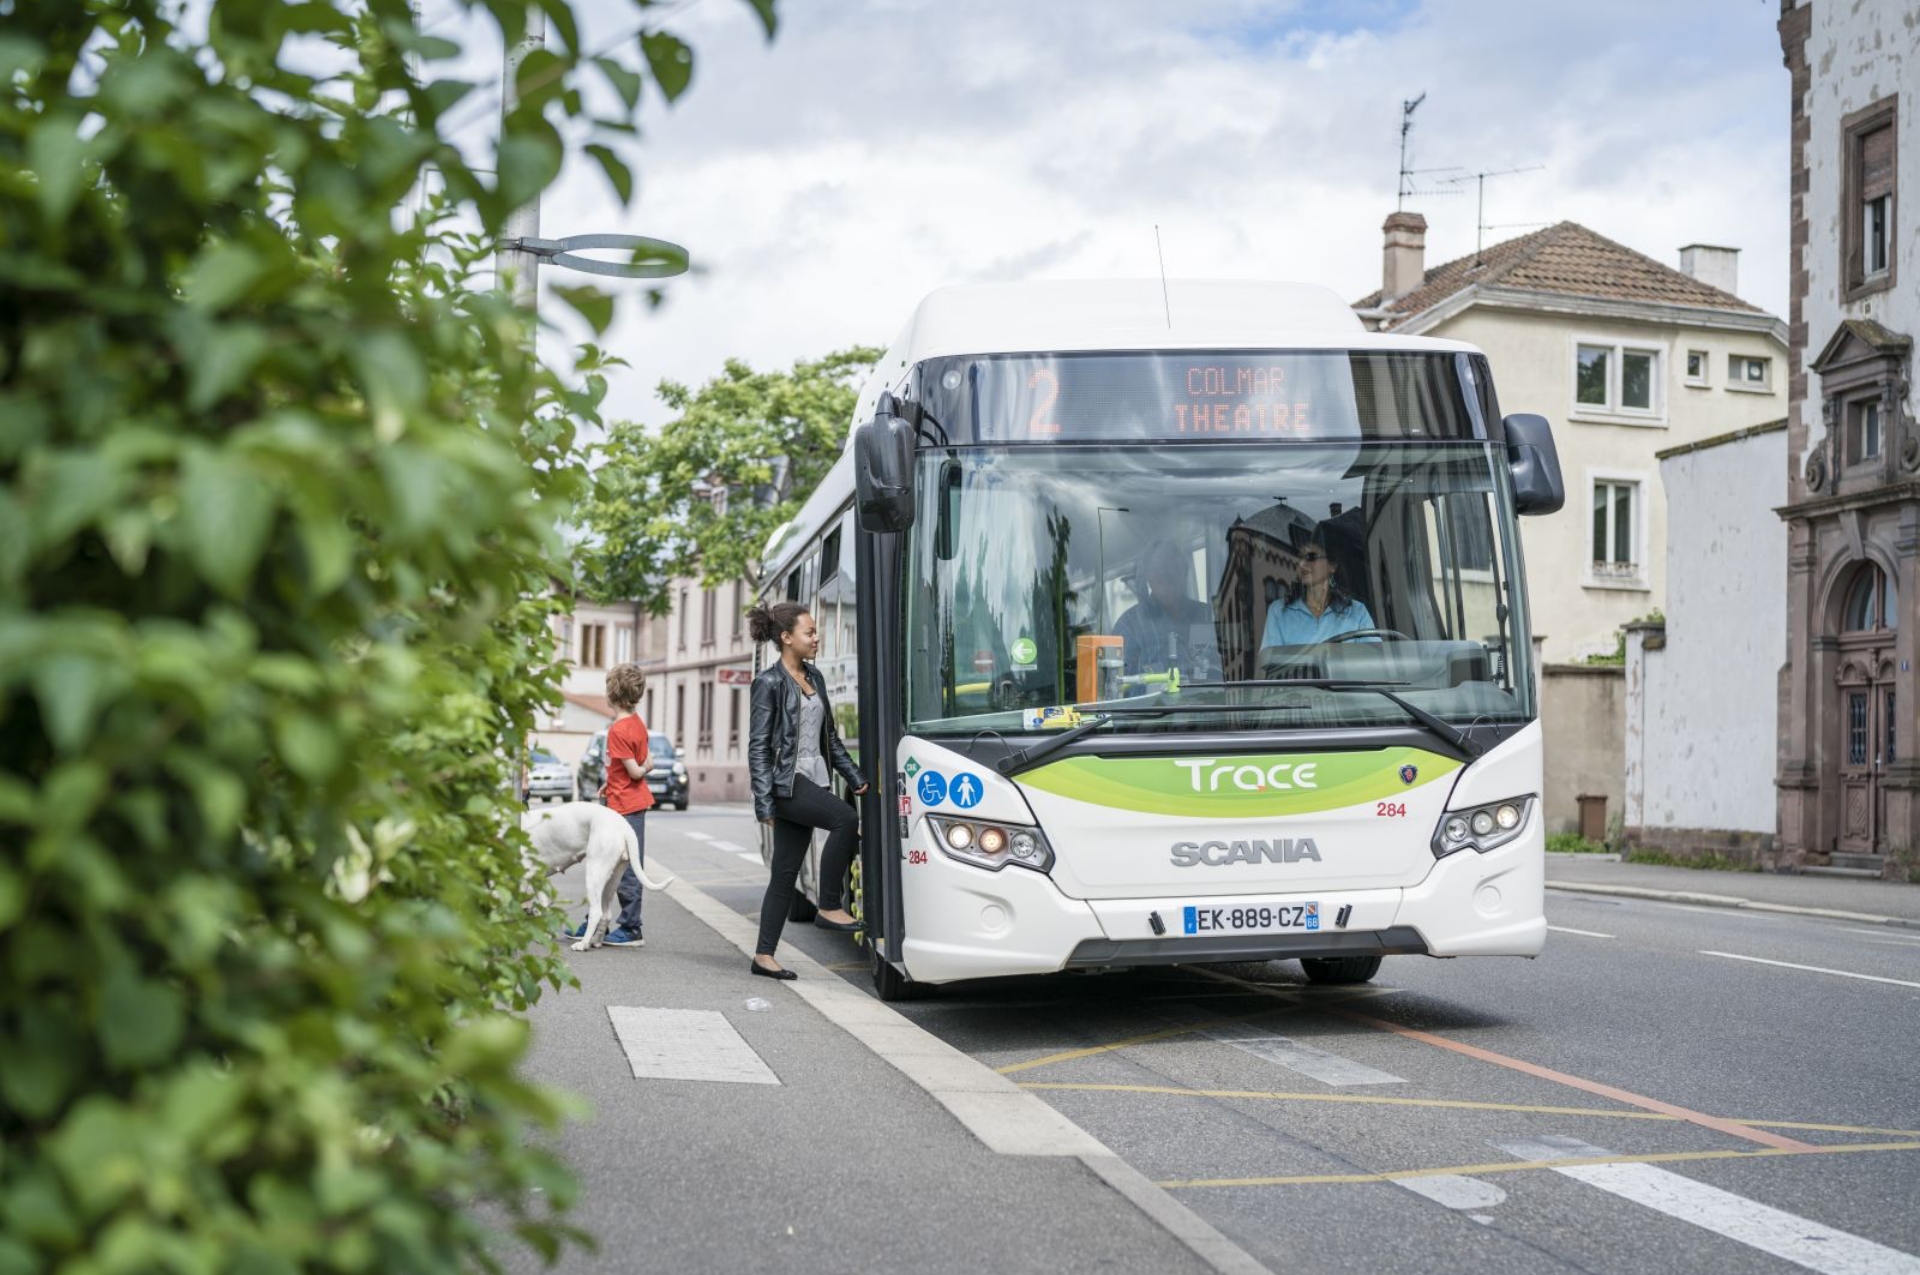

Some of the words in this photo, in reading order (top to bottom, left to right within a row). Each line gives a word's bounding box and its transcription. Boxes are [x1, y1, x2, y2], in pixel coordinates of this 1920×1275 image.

[1187, 367, 1285, 395] COLMAR
[1028, 369, 1061, 434] 2
[1174, 403, 1310, 432] THEATRE
[1377, 802, 1406, 817] 284
[909, 850, 928, 864] 284
[1170, 838, 1322, 867] SCANIA
[1198, 907, 1305, 930] EK-889-CZ
[1307, 917, 1318, 928] 68
